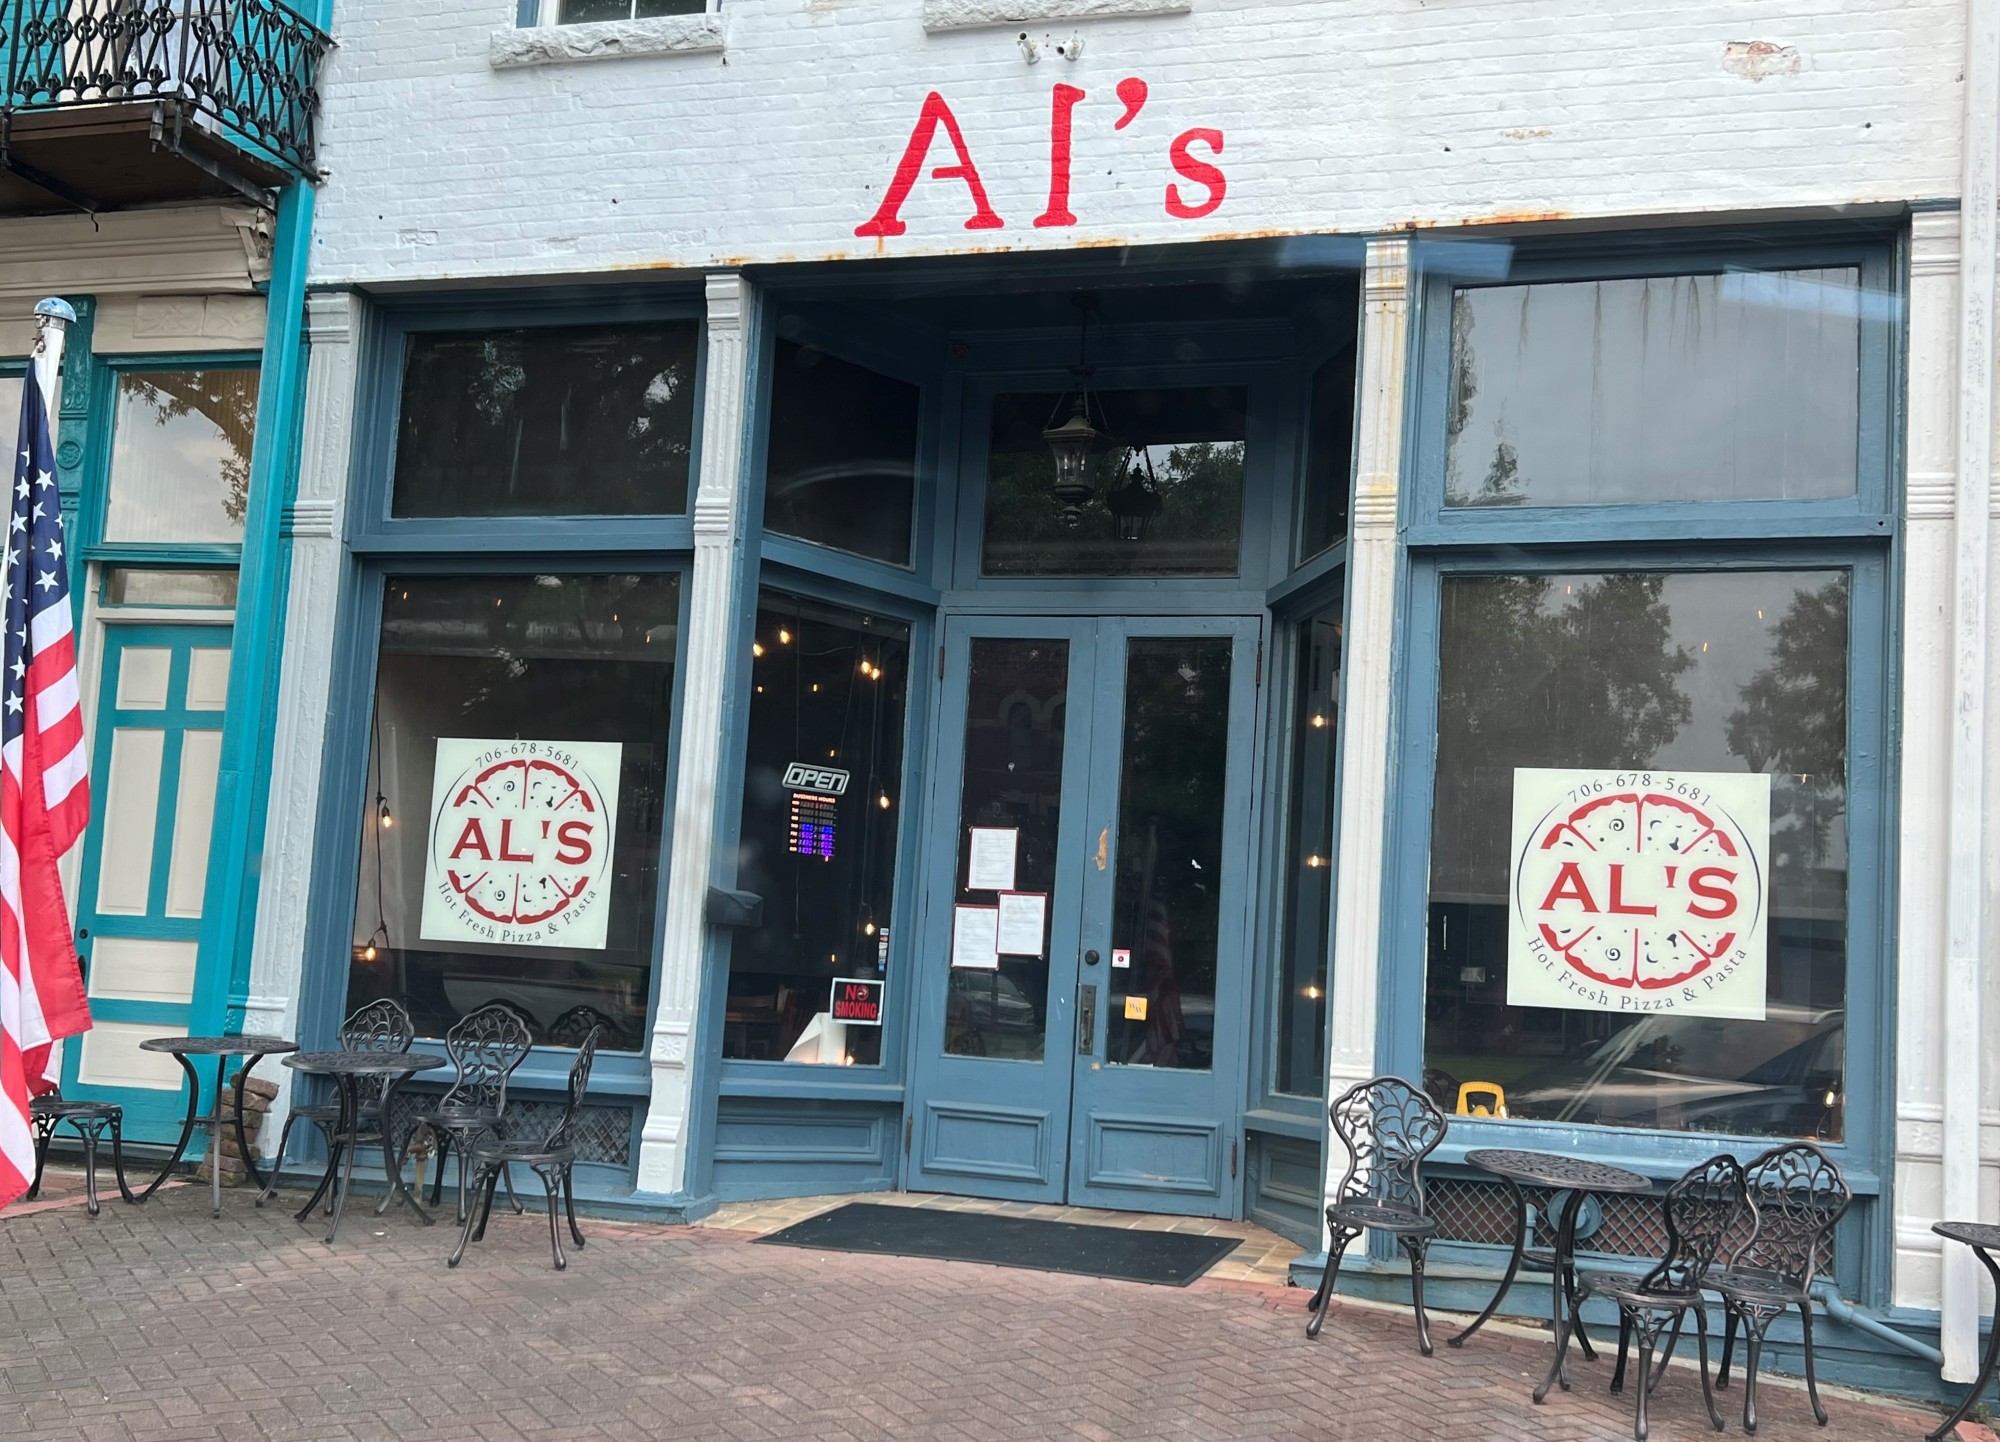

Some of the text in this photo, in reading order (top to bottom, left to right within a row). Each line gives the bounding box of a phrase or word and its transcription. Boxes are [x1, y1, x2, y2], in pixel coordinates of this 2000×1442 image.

[854, 77, 1227, 237] Al's
[475, 742, 579, 771] 706-678-5681
[787, 767, 846, 791] OPEN
[1567, 773, 1712, 807] 706-678-5681
[448, 817, 594, 865] AL'S
[1538, 861, 1738, 919] AL'S
[438, 881, 597, 942] Hot Fresh Pizza & Pasta
[845, 984, 869, 1002] NO
[1527, 936, 1747, 1011] Hot Fresh Pizza & Pasta
[834, 1001, 877, 1019] SMOKING
